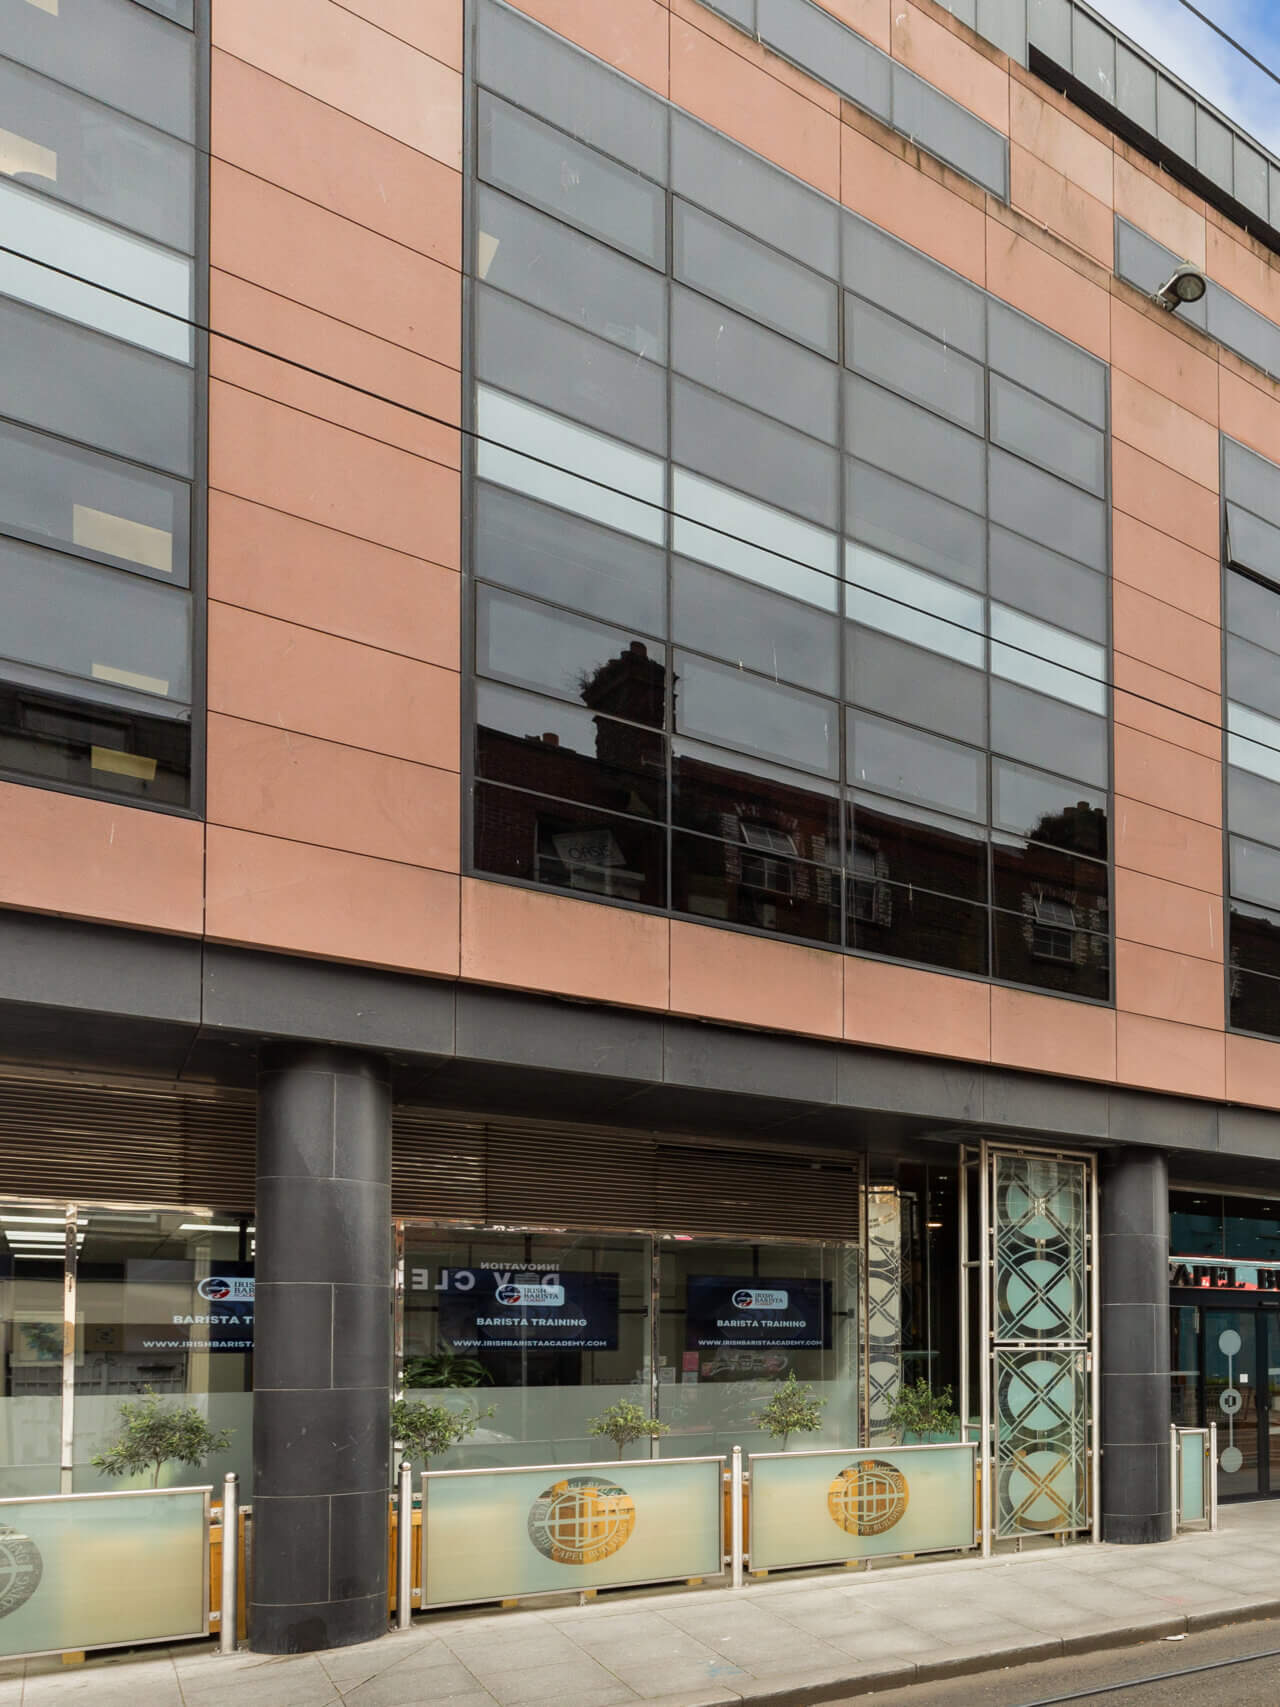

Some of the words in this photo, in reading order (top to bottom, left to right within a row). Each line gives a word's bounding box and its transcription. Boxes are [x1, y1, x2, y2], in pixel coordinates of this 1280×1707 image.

[172, 1315, 240, 1325] BARISTA
[476, 1317, 529, 1326] BARISTA
[531, 1318, 587, 1327] TRAINING
[716, 1319, 759, 1328] BARISTA
[760, 1320, 806, 1328] TRAINING
